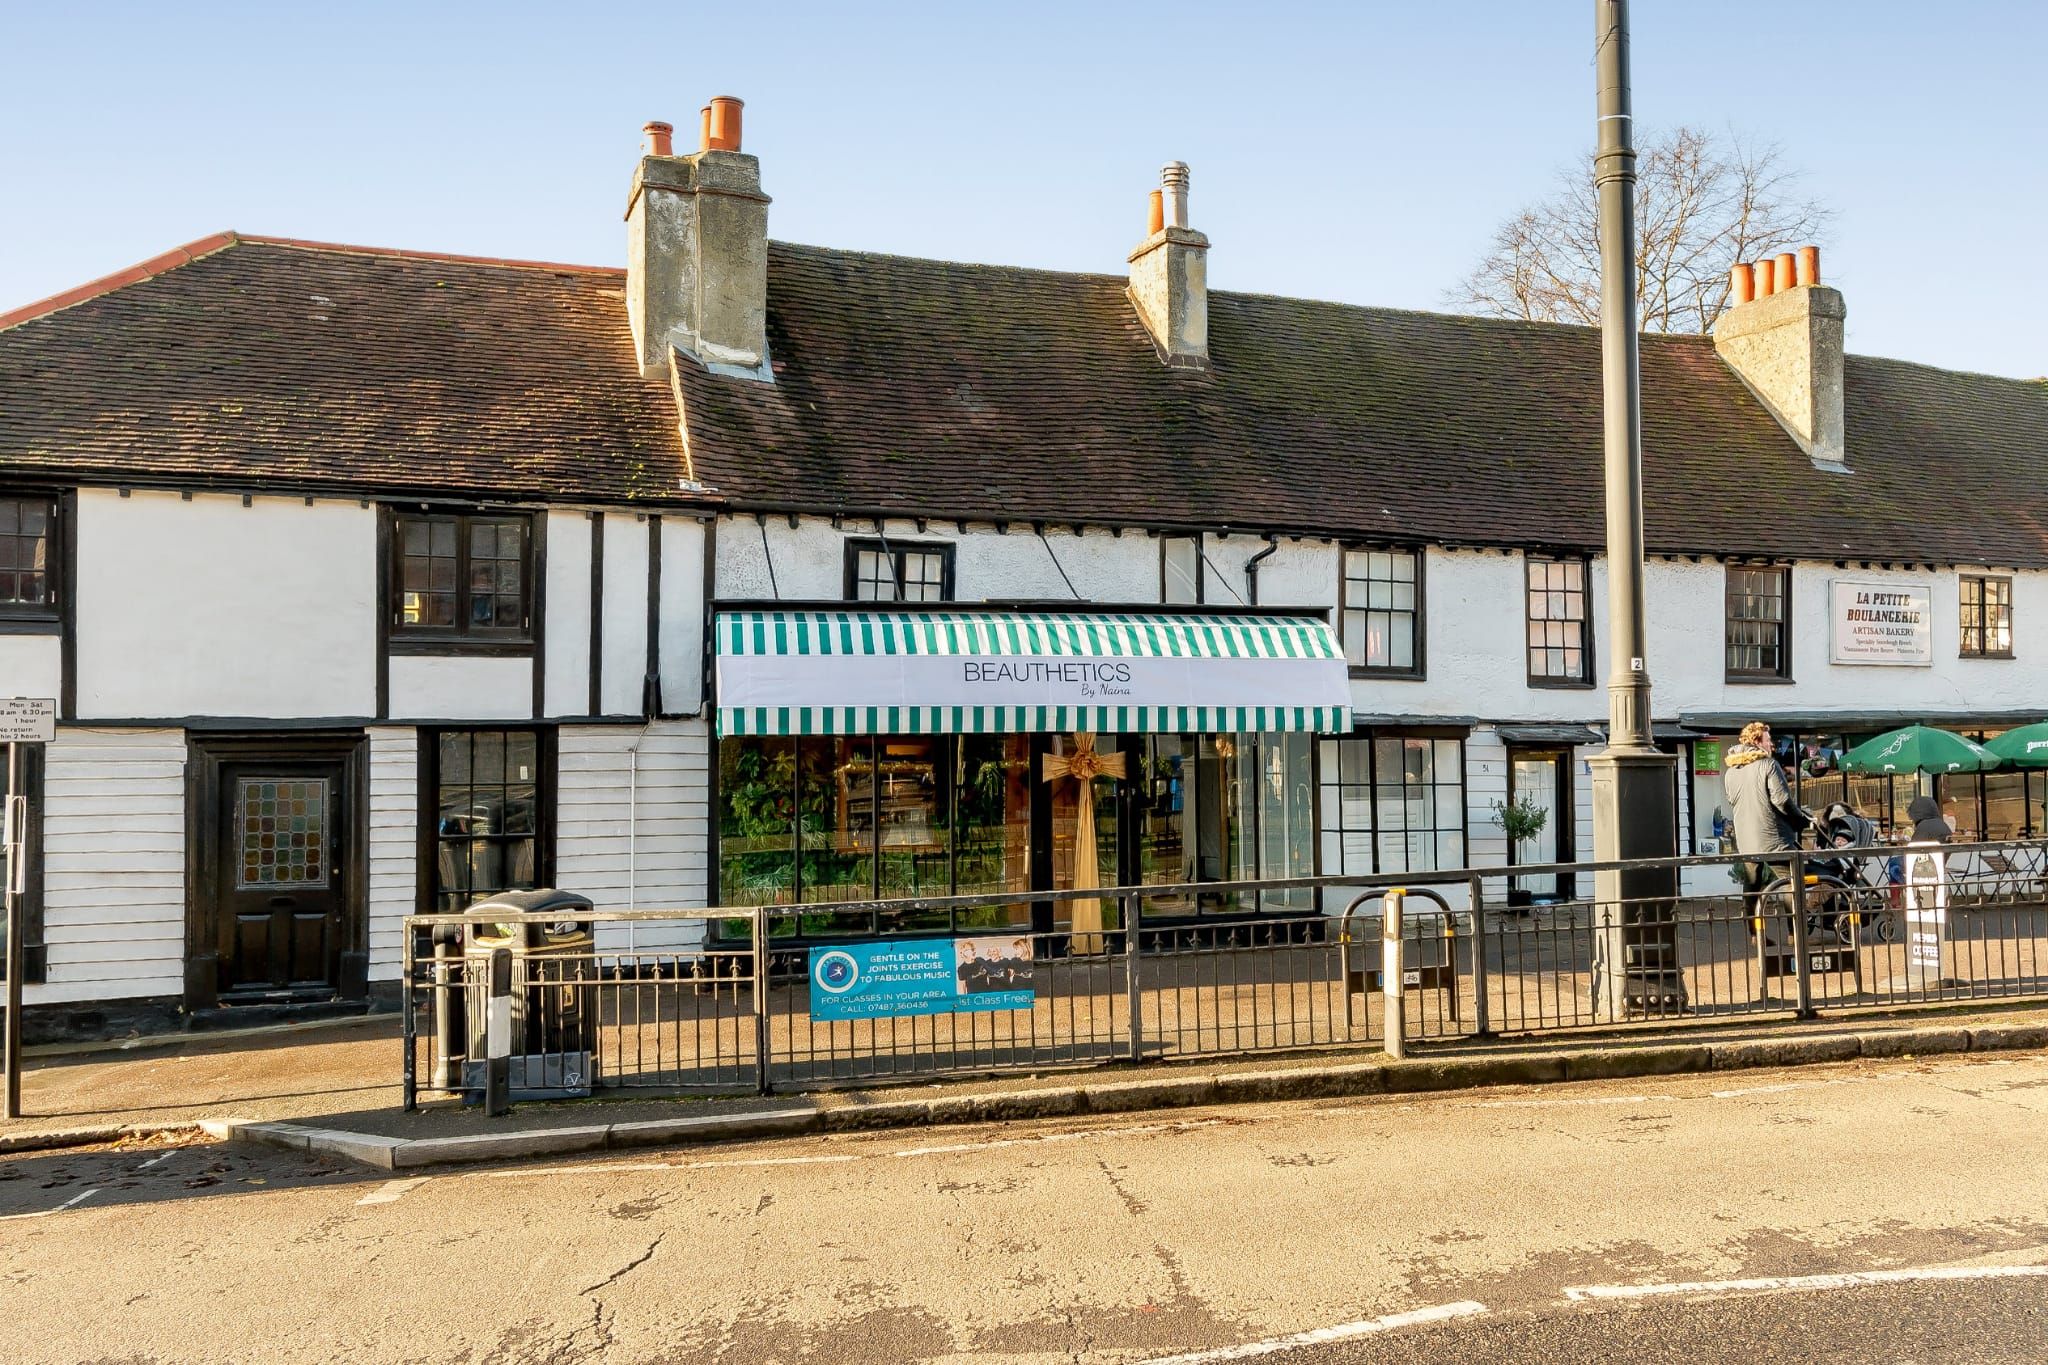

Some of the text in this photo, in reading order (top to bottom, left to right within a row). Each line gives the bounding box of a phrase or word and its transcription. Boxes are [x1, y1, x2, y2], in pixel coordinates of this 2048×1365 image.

[1857, 592, 1911, 606] LA PETITE
[1847, 609, 1920, 623] BOULANGERIE
[1852, 627, 1915, 637] ARTISAN BAKERY
[964, 662, 1131, 682] BEAUTHETICS
[1081, 684, 1131, 698] By Naina
[870, 952, 940, 963] GENTLE ON THE
[867, 962, 944, 974] JOINTS EXERCISE
[860, 971, 951, 984] TO FABULOUS MUSIC
[821, 990, 947, 1004] FOR CLASSES IN YOUR AREA
[974, 995, 1000, 1005] Class
[840, 1005, 866, 1013] CALL:
